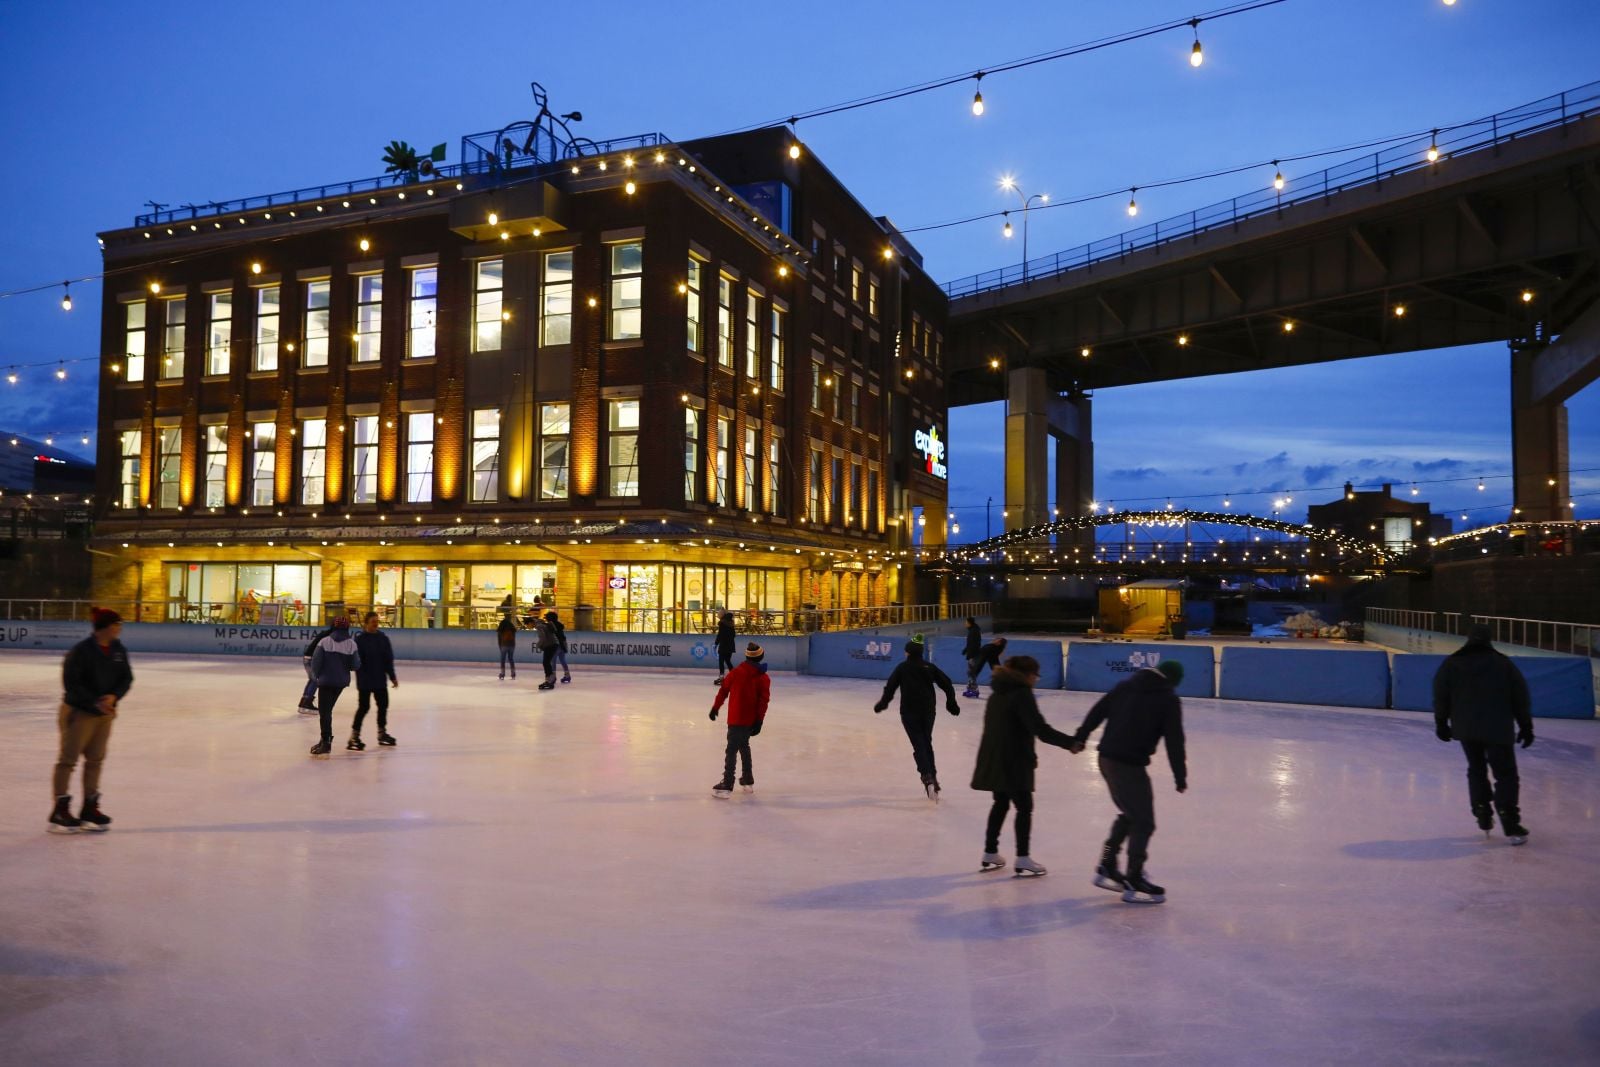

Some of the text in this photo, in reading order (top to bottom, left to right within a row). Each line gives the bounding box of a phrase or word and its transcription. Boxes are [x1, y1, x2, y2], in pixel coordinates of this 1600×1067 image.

[8, 628, 28, 641] UP
[241, 629, 296, 640] CAROLL
[570, 643, 671, 657] IS CHILLING AT CANALSIDE
